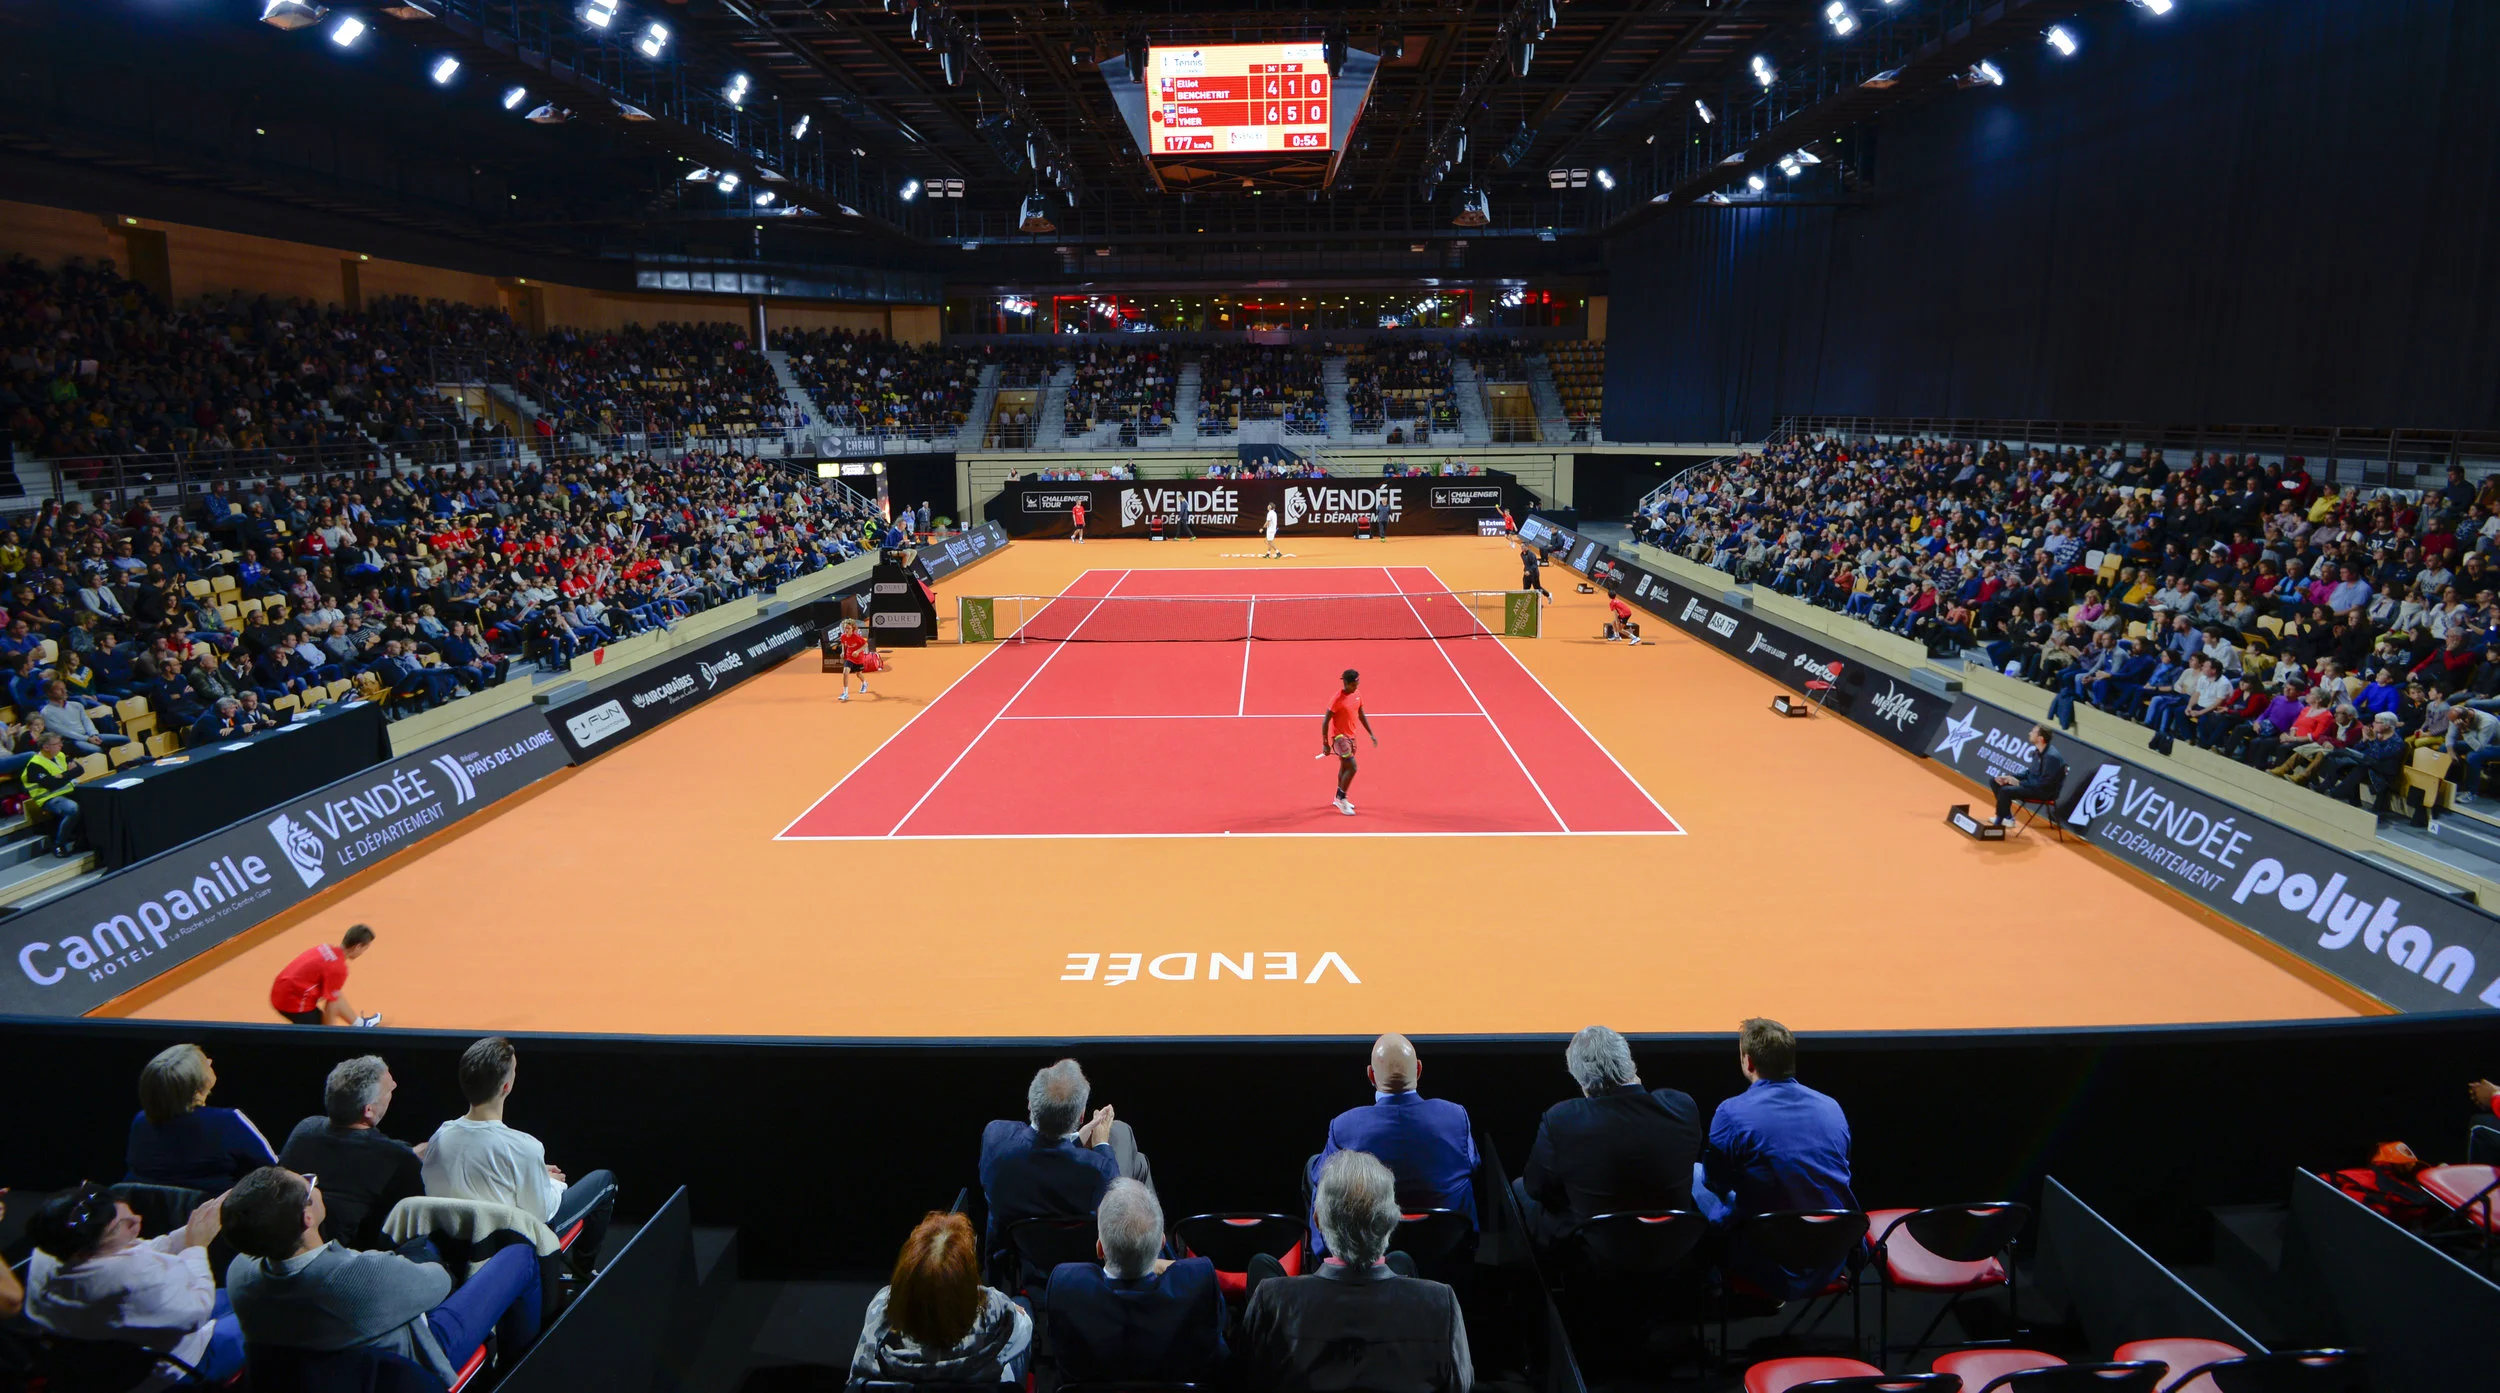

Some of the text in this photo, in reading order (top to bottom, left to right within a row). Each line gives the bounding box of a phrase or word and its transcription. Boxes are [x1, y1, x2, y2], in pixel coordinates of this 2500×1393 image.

[1176, 79, 1199, 88] Elliot
[1267, 79, 1321, 95] 4 1 0
[1177, 90, 1230, 100] BENCHETRIT
[1178, 106, 1199, 114] Elias
[1267, 105, 1321, 122] 6 5 0
[1178, 117, 1203, 126] YMER
[1167, 137, 1213, 150] 177 km/h
[1292, 135, 1318, 146] 0:56
[845, 440, 876, 451] CHENU
[1143, 485, 1239, 512] VENDÉE
[1307, 484, 1402, 511] VENDÉE
[1163, 513, 1238, 525] DÉPRTEMENT
[1308, 511, 1402, 523] LE DÉPARTEMNT
[1482, 528, 1497, 536] 177
[1710, 615, 1736, 633] ASA TP
[588, 705, 620, 726] FUN
[1871, 692, 1919, 725] Mercure
[466, 729, 555, 778] PAYS DE LA LOIRE
[305, 768, 435, 840] VENDÉE
[336, 801, 446, 866] LE DÉPARTEMENT
[2121, 778, 2253, 870] VENDÉE
[2101, 821, 2225, 892] LE DÉPARTEMENT
[18, 855, 272, 986] Campanile
[179, 921, 205, 936] Roche
[204, 914, 217, 924] sur
[216, 906, 233, 917] Yon
[2231, 857, 2476, 995] polytan
[88, 946, 154, 983] HOTEL
[1060, 951, 1362, 986] VENDÉE
